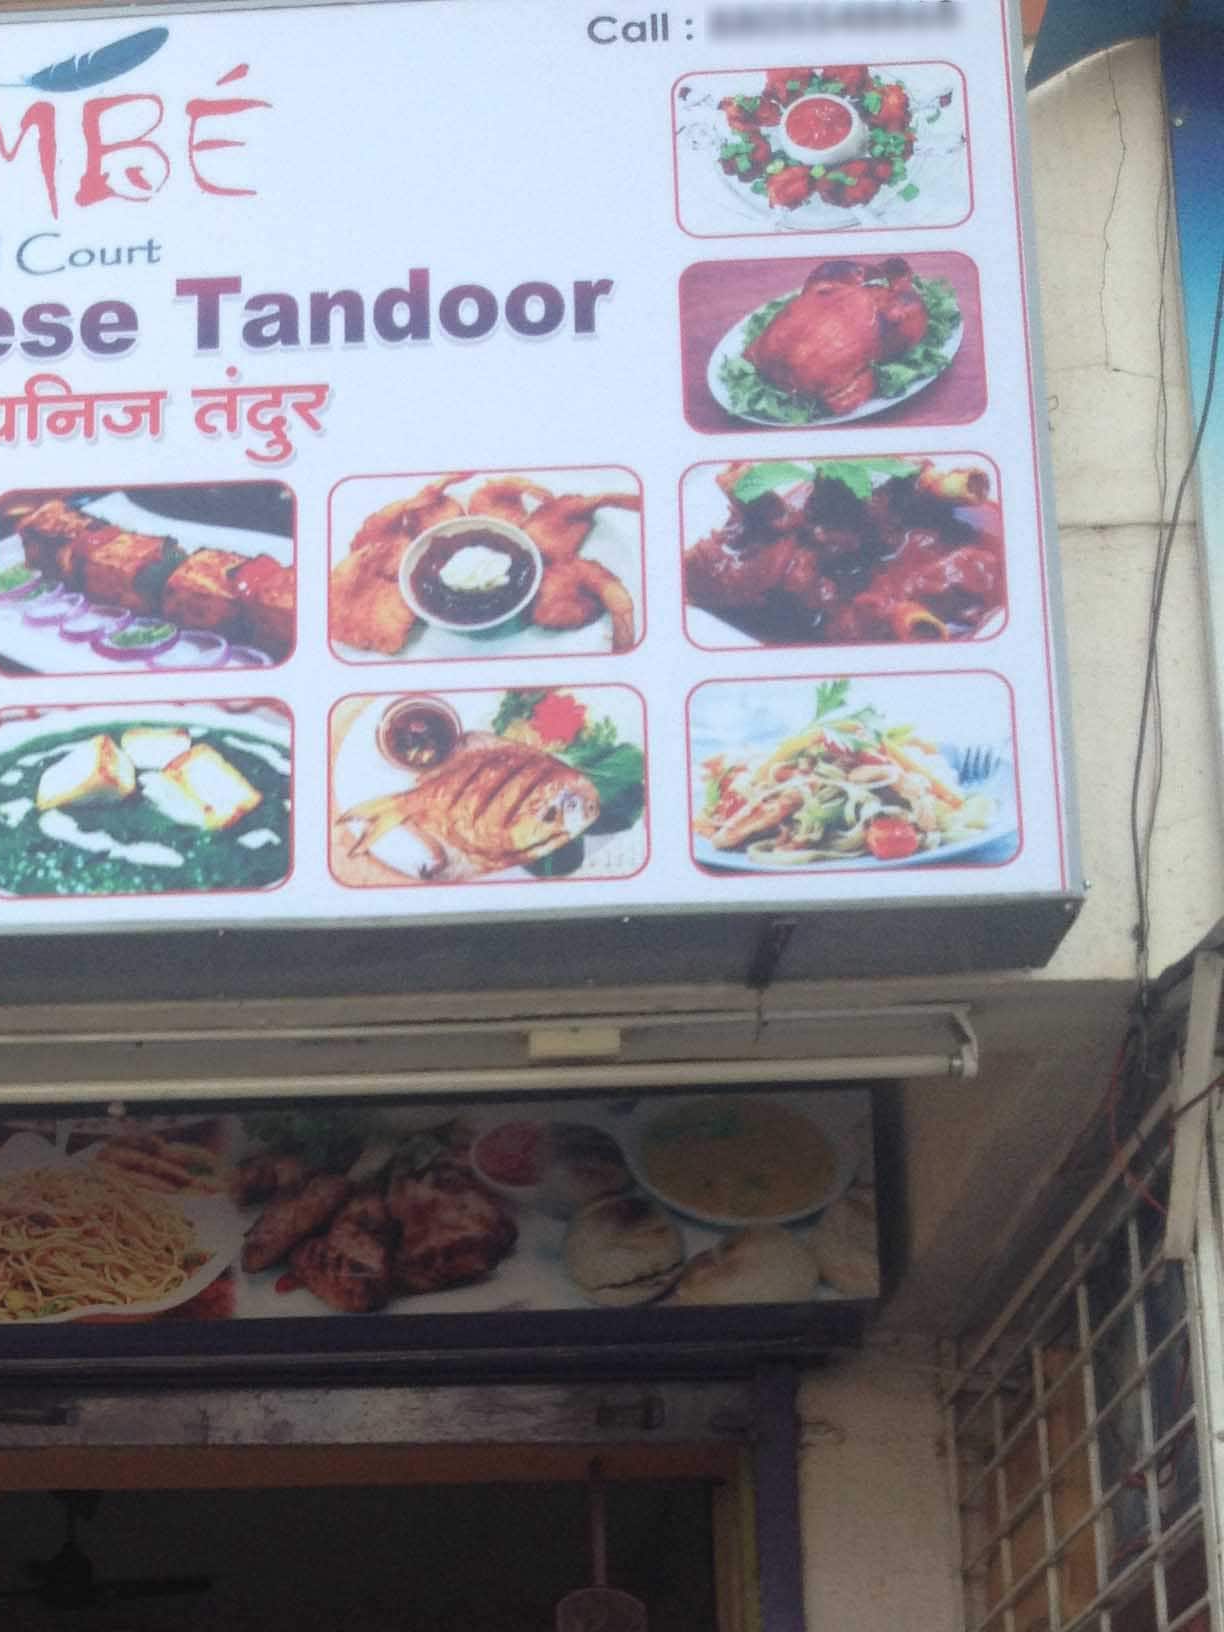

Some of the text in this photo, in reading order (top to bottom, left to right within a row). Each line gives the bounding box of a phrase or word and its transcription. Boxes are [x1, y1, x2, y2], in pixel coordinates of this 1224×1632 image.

[587, 13, 669, 45] Call
[16, 232, 163, 276] Court
[176, 269, 614, 352] Tandoor
[192, 366, 329, 462] तंदुर
